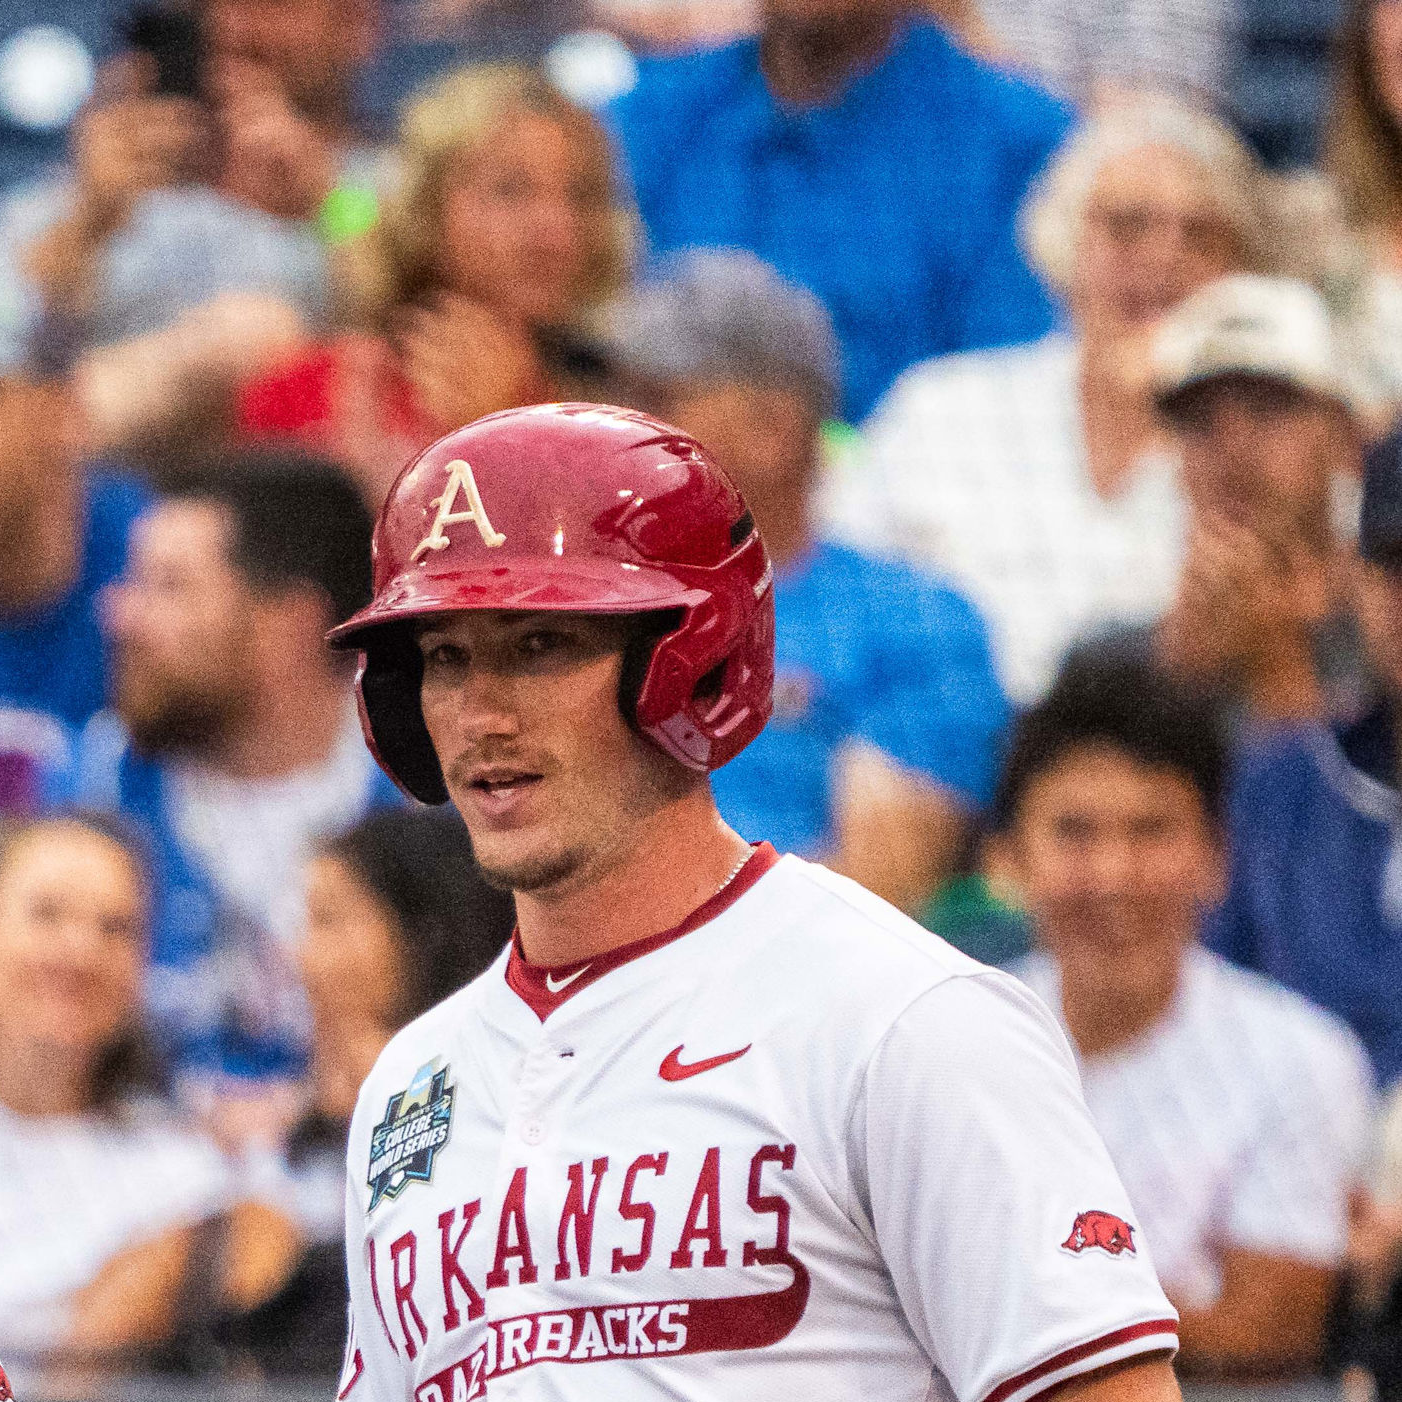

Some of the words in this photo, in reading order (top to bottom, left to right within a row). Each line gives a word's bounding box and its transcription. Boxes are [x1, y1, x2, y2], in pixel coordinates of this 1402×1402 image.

[409, 458, 507, 561] A
[384, 1111, 435, 1149] COLLEGE
[404, 1123, 449, 1156] SERIES
